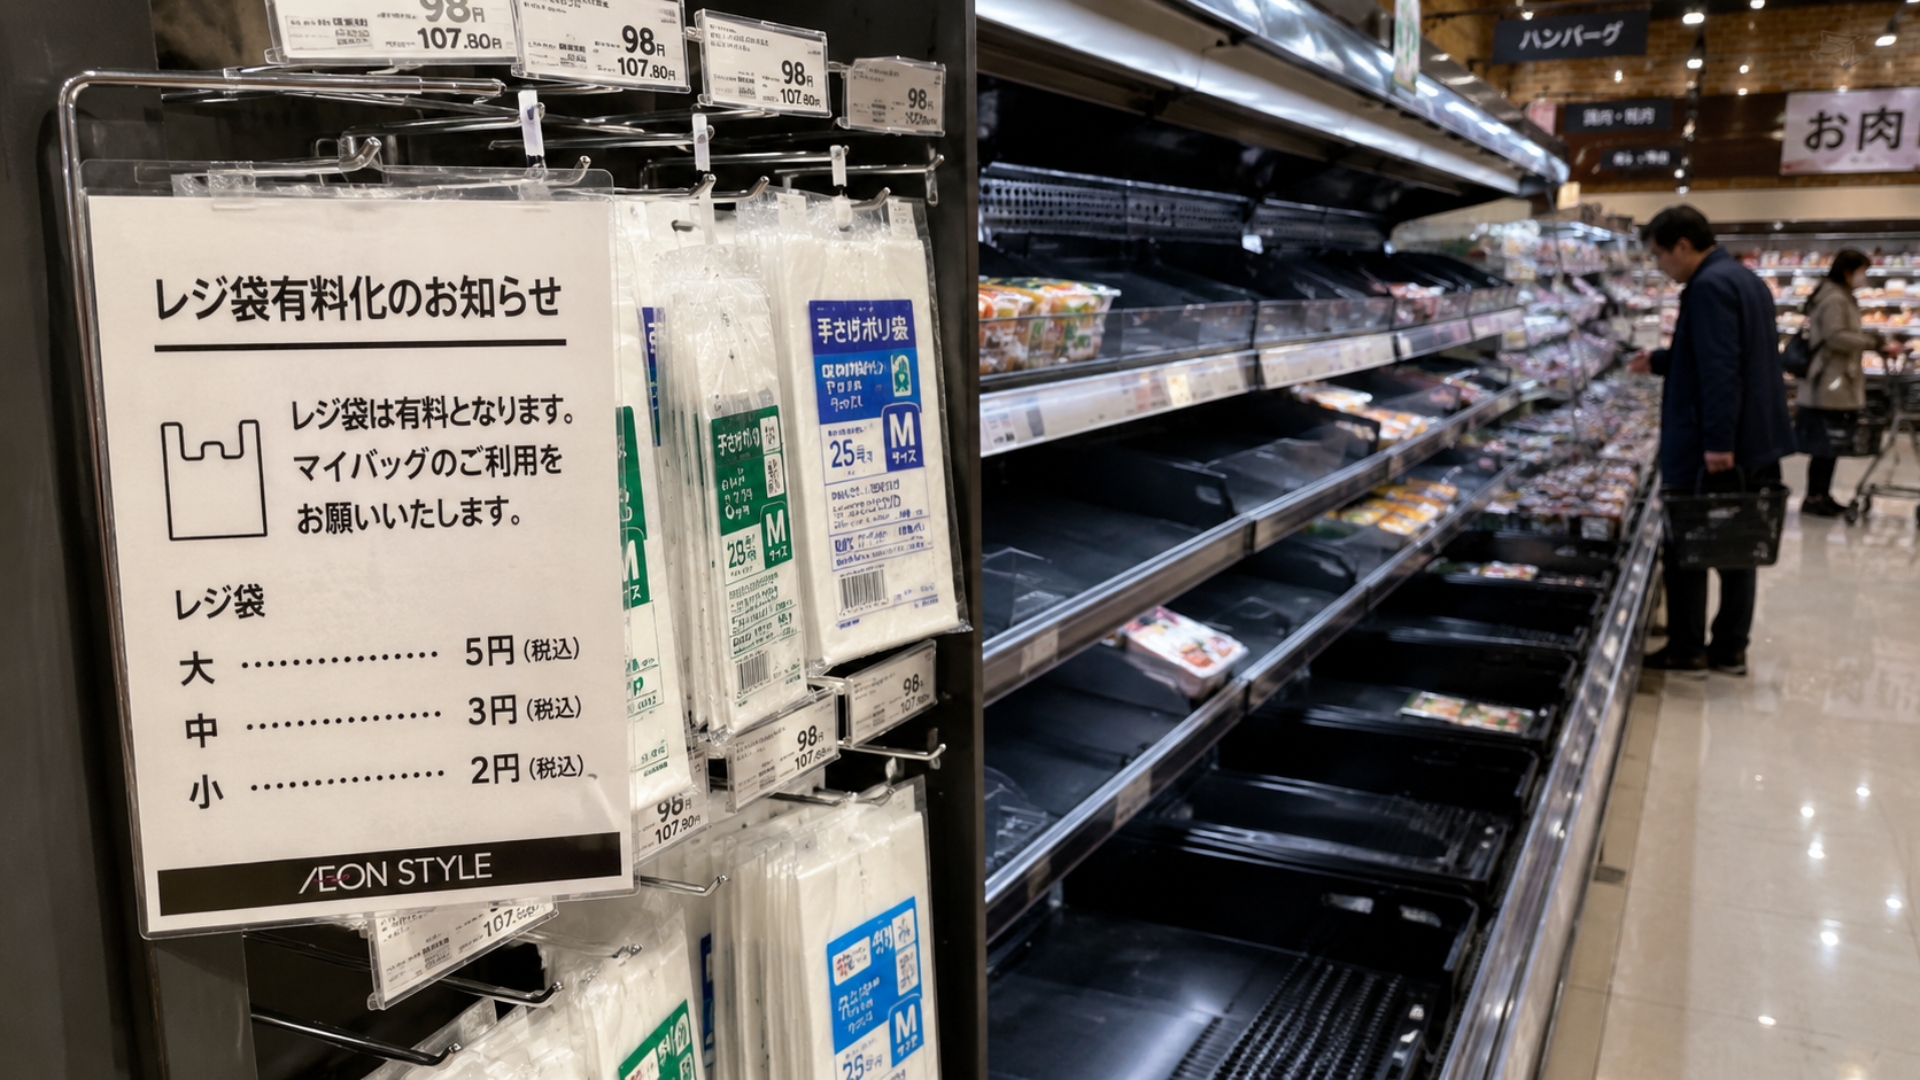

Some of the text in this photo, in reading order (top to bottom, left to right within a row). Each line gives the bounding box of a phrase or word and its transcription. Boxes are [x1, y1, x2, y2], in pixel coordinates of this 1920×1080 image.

[417, 27, 502, 49] 107.80円
[622, 25, 666, 57] 98円
[617, 57, 676, 81] 107.80円
[781, 60, 813, 87] 98円
[1804, 106, 1920, 152] お肉
[155, 274, 562, 323] レジ袋有料化のお知らせ
[291, 394, 573, 431] レジ袋は有料となります。
[889, 411, 915, 449] M
[293, 444, 563, 483] マイバッグのご利用を
[297, 496, 520, 535] お願いいたします。
[766, 509, 786, 548] M
[175, 583, 266, 621] レジ袋
[180, 635, 580, 686] 大 5円 (税込)
[185, 694, 582, 748] 中 3円 (税込)
[189, 753, 584, 809] 小 2円 (税込)
[398, 852, 493, 886] STYLE
[895, 1003, 917, 1045] M
